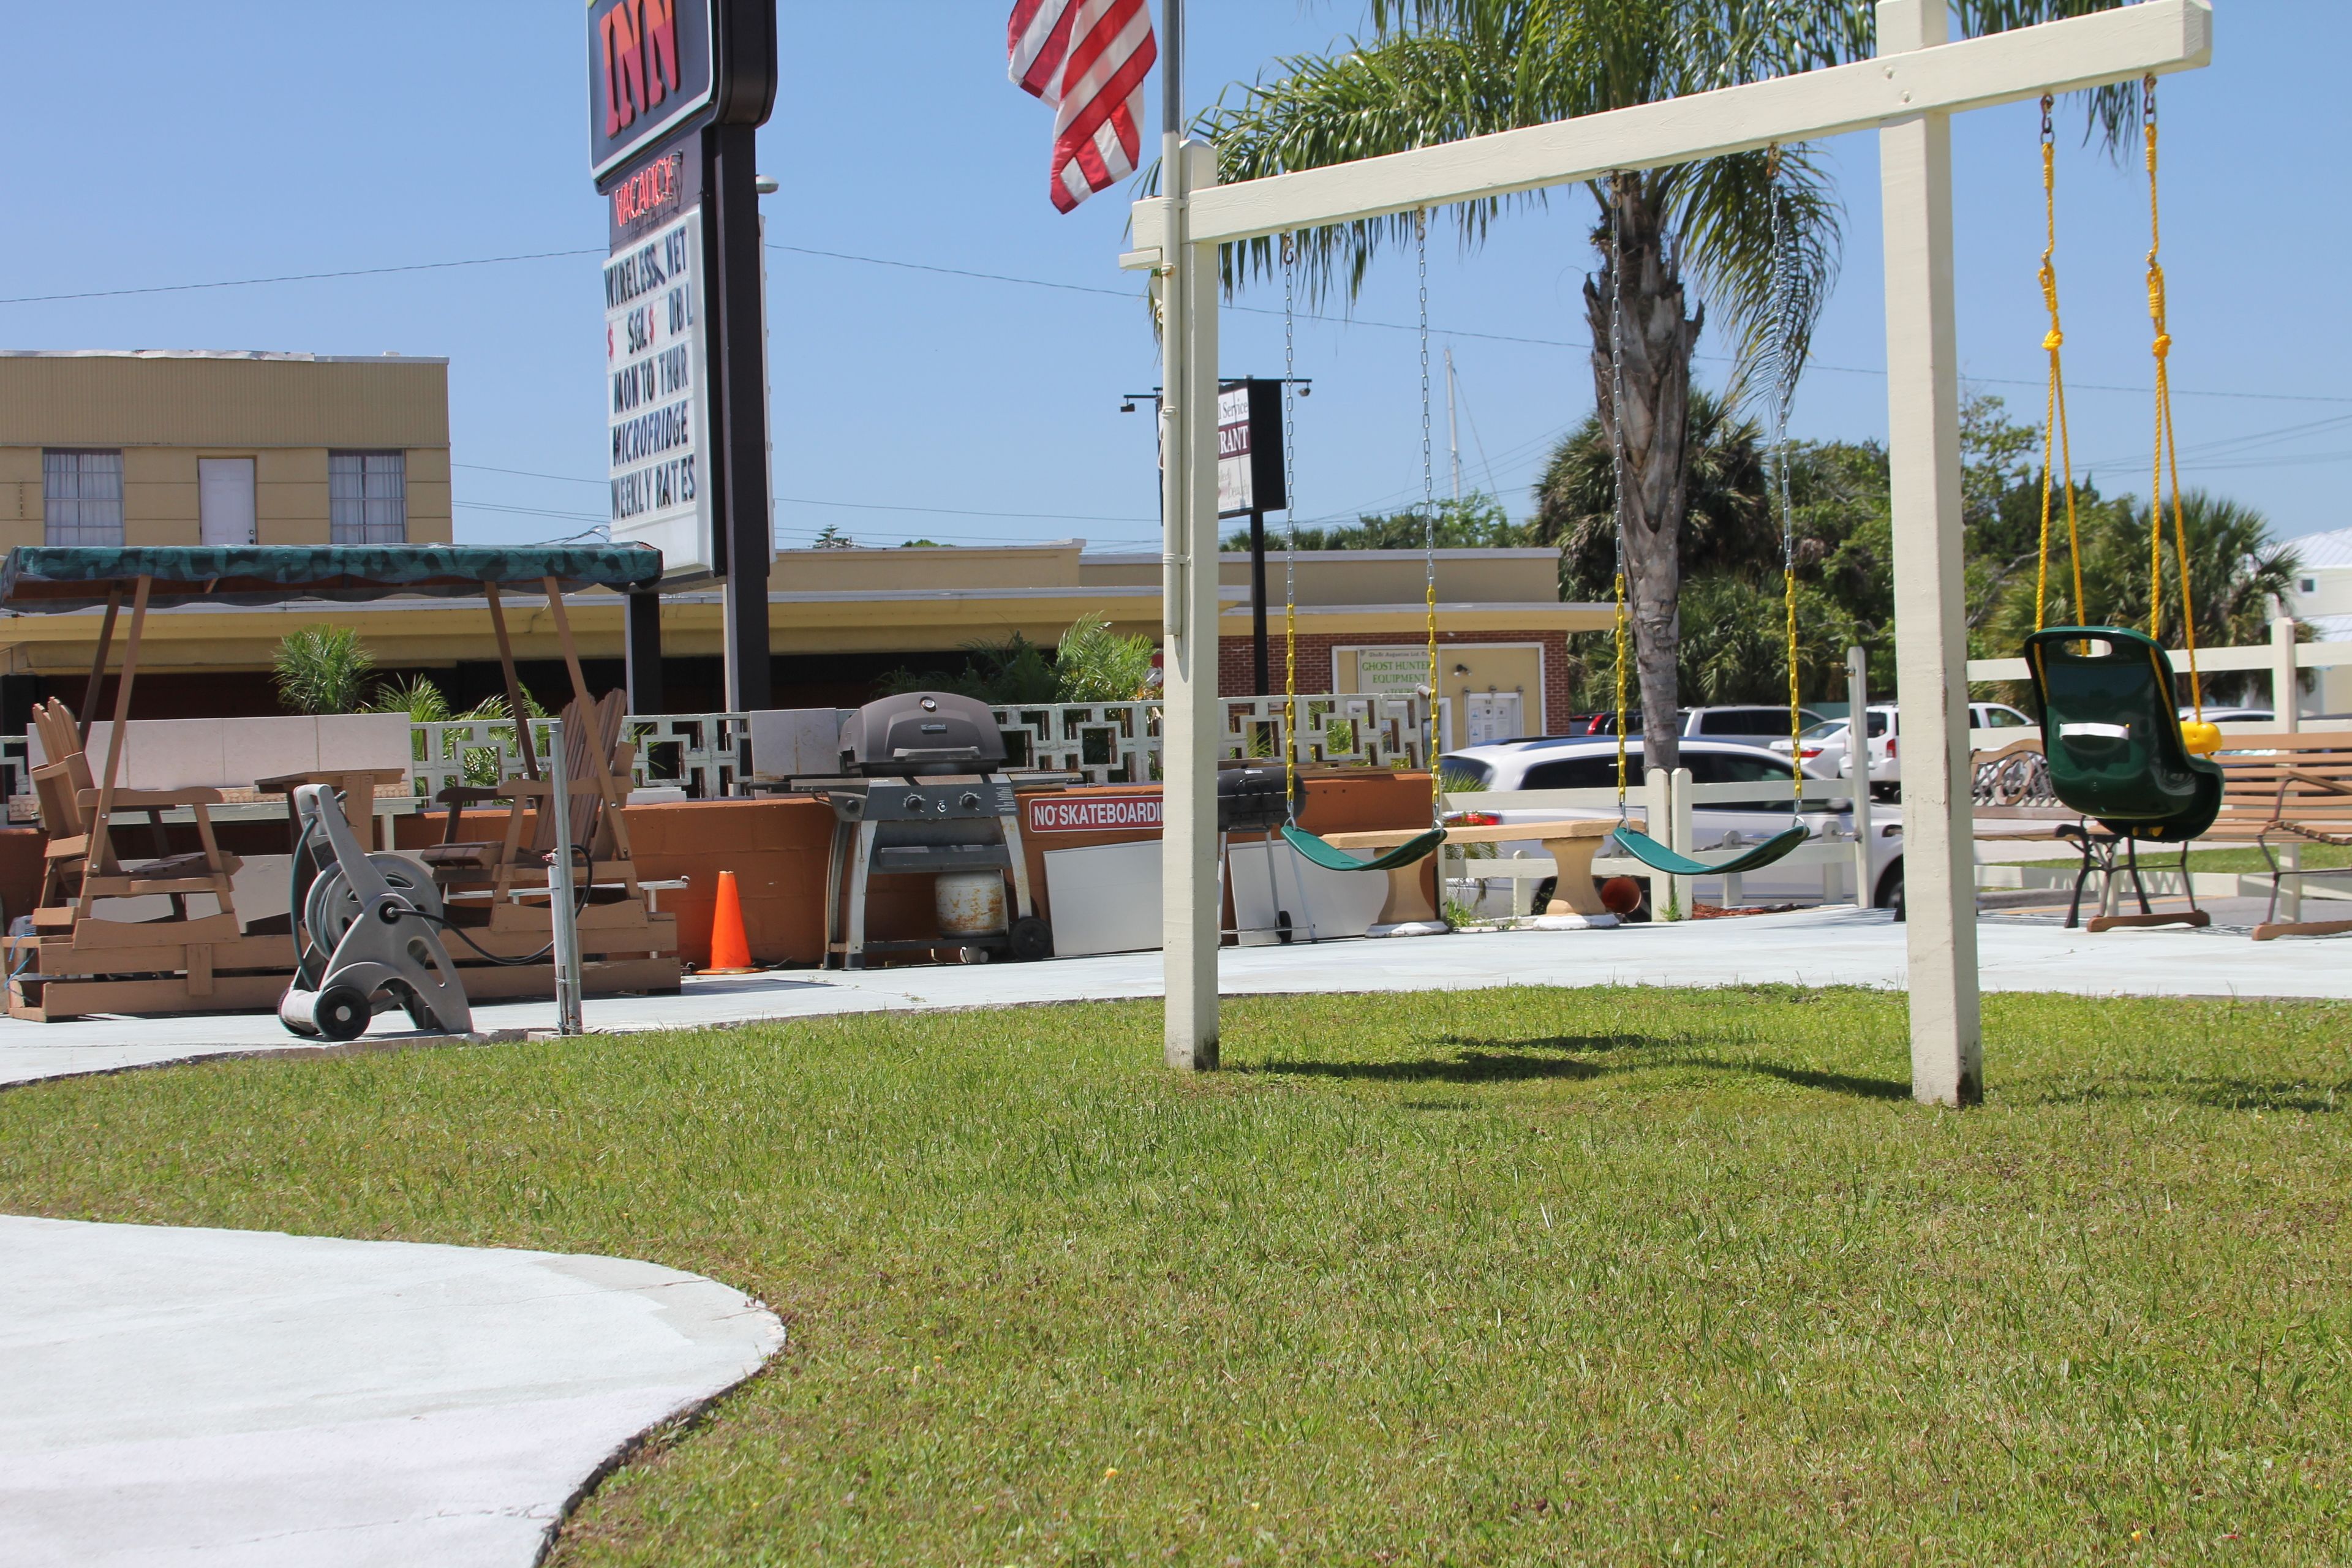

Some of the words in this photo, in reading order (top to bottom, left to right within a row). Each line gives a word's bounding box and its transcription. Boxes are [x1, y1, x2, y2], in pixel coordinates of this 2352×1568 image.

[600, 0, 679, 138] INN
[615, 157, 674, 227] VACANCY
[604, 244, 658, 309] WIRELESS
[666, 226, 687, 278] NET
[628, 306, 647, 355] SGL
[669, 283, 693, 336] DBL
[614, 365, 638, 413] MON
[640, 358, 655, 403] TO
[659, 343, 688, 396] THUR
[1223, 398, 1248, 419] Service
[613, 401, 687, 467] MICROFRIDGE
[611, 467, 654, 520] WEEKLY
[656, 454, 696, 509] RATES
[1362, 662, 1392, 671] GHOST
[1373, 674, 1425, 683] EQUIPMENT
[1035, 805, 1055, 826] NO
